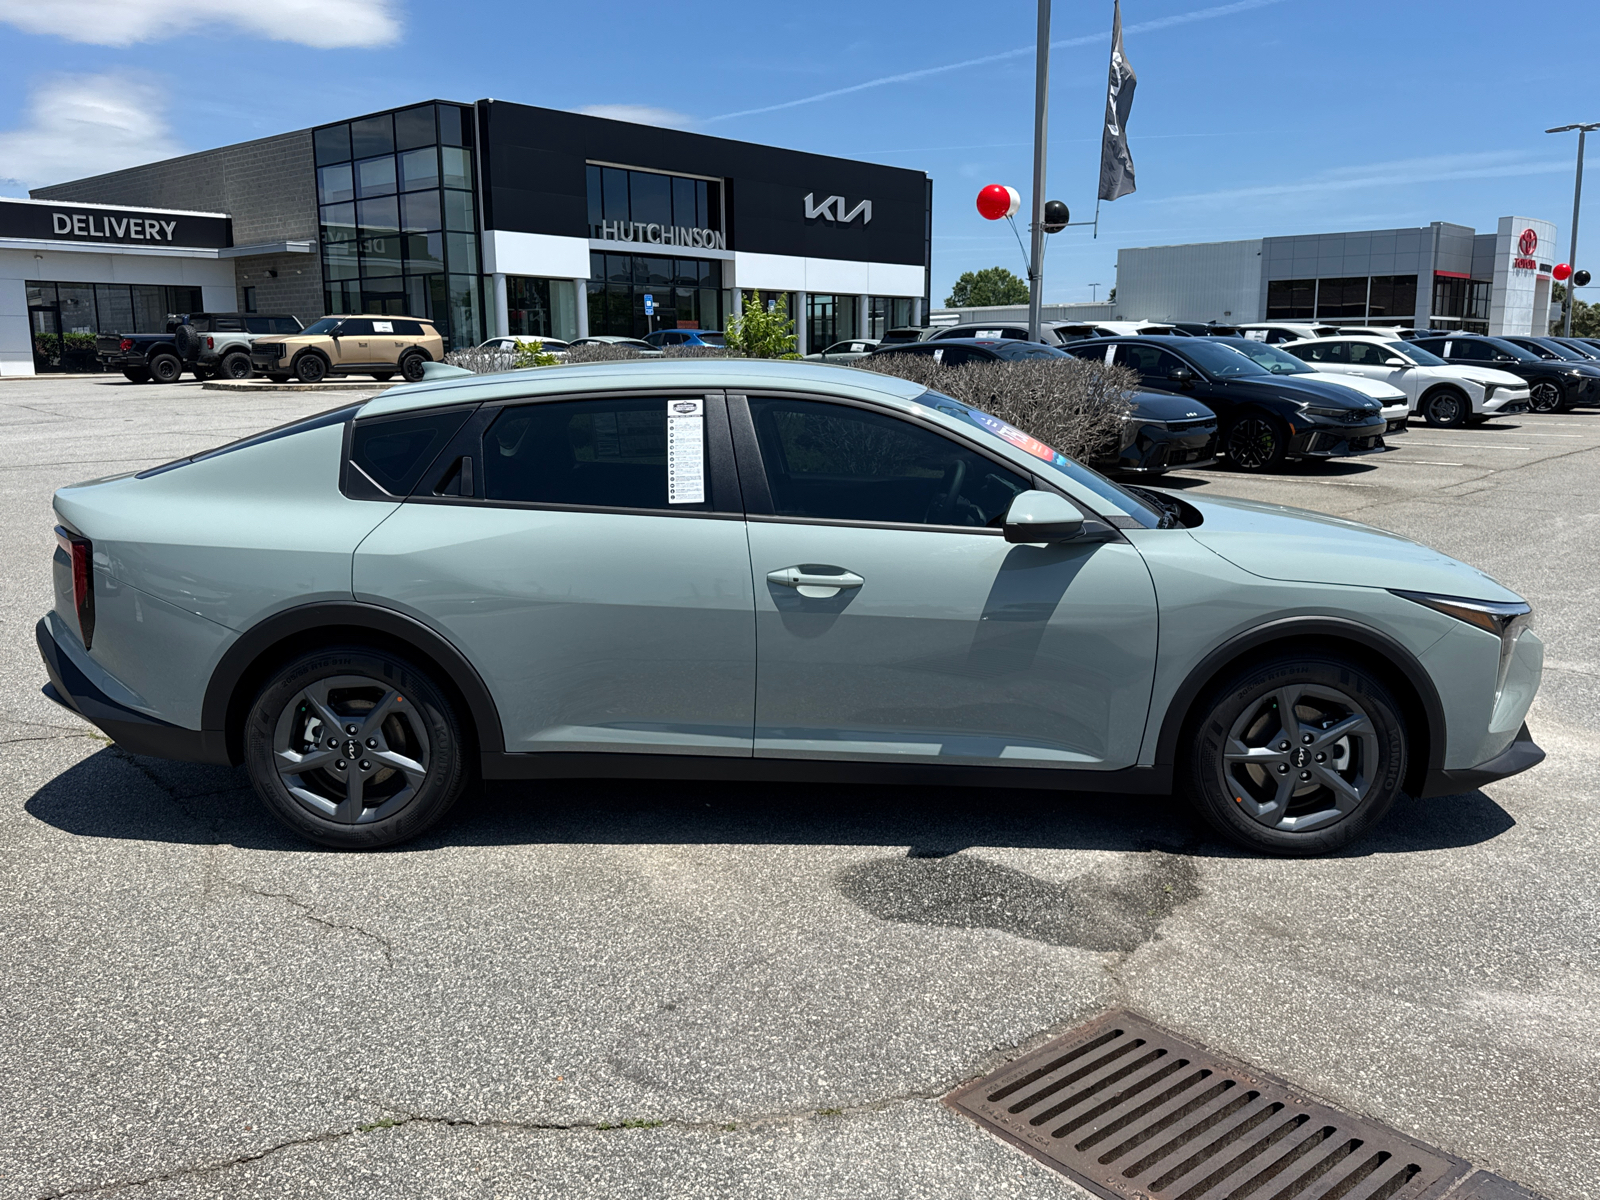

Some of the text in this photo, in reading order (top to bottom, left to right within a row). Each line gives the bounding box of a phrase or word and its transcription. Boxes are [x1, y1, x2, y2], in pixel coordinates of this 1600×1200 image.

[804, 192, 872, 225] KIA
[52, 213, 177, 241] DELIVERY
[602, 219, 727, 251] HUTCHINSON
[311, 661, 329, 671] R16
[332, 658, 353, 666] 91H
[1268, 671, 1287, 681] R16
[1289, 666, 1310, 675] 91H
[435, 725, 449, 787] KUMHO
[1384, 728, 1400, 791] KUMHO
[1026, 1131, 1051, 1147] USA
